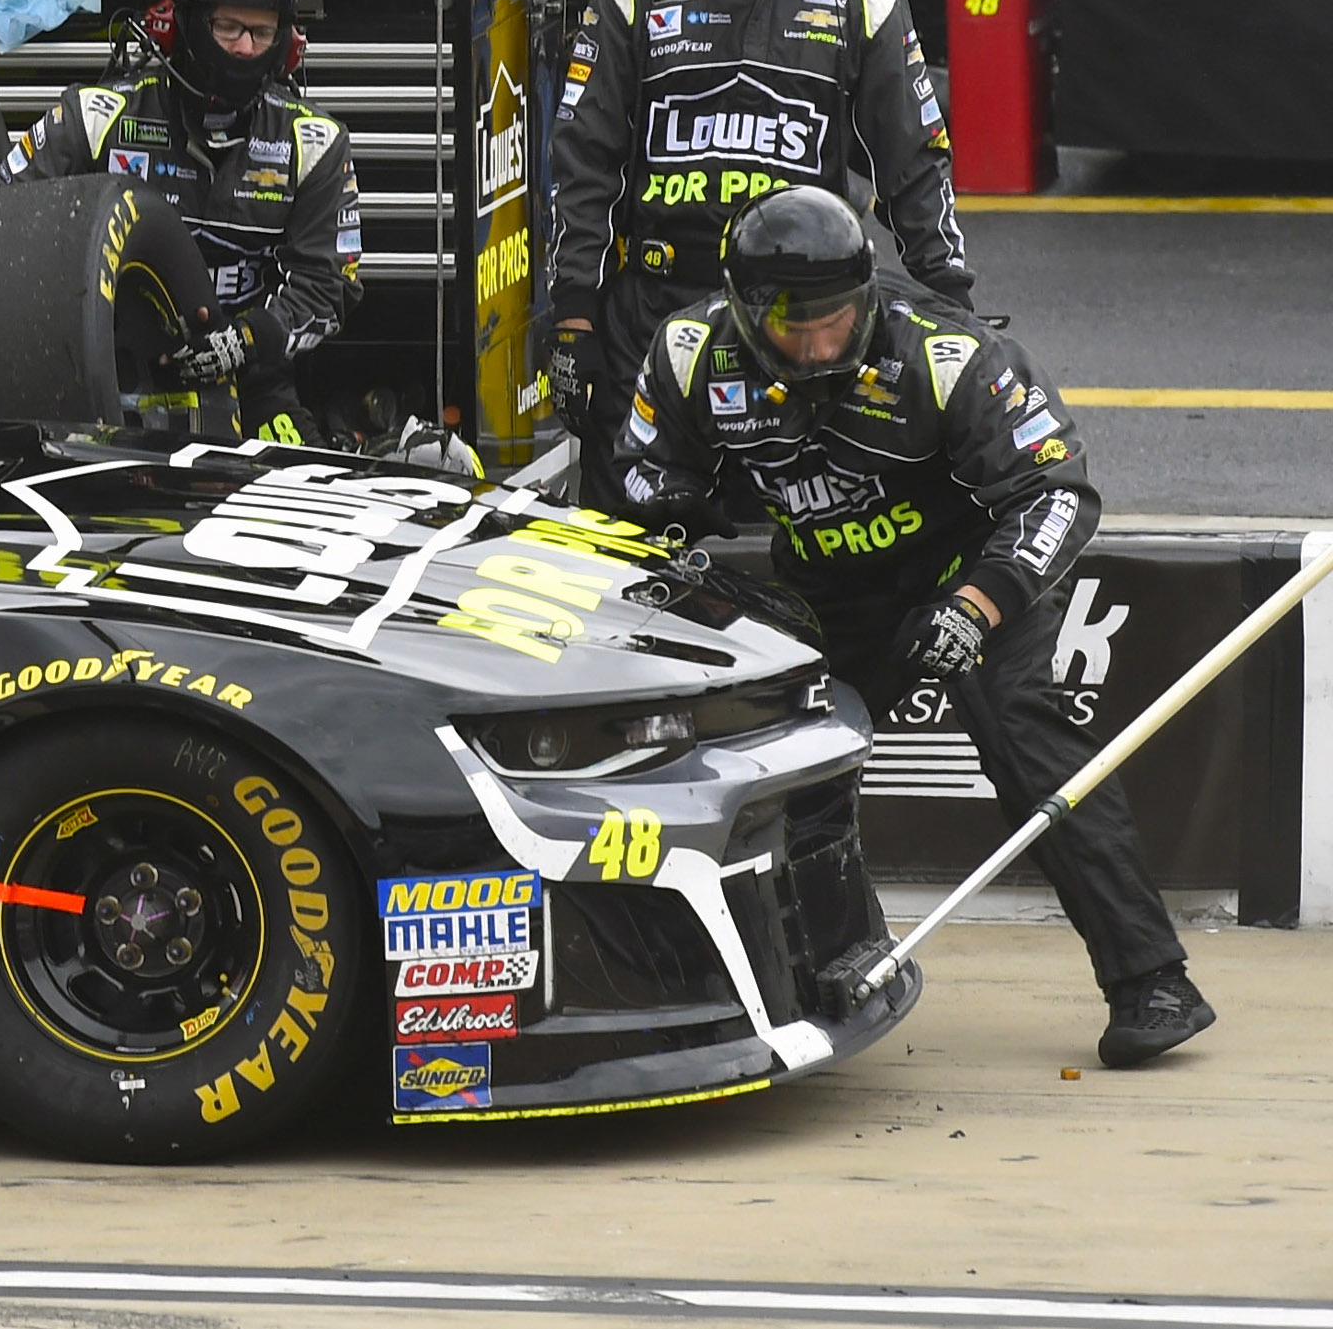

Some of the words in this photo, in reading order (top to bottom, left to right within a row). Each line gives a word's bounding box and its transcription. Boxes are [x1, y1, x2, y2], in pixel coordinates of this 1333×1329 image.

[481, 113, 523, 193] LOWE'S
[666, 109, 808, 161] LOWE'S
[641, 170, 709, 206] FOR
[477, 242, 498, 306] FOR
[499, 227, 529, 290] PROS
[644, 249, 663, 266] 48
[812, 500, 923, 557] PROS
[1018, 488, 1078, 570] LOWE'S
[588, 808, 662, 881] 48
[386, 874, 535, 913] MOOG
[194, 775, 336, 1124] GOODYEAR
[387, 910, 528, 953] MAHLE
[403, 959, 506, 989] COMP
[472, 977, 524, 989] CAMS
[186, 1010, 215, 1036] AERO
[397, 1004, 515, 1036] Edelbrock
[402, 1068, 485, 1089] SUNOCO
